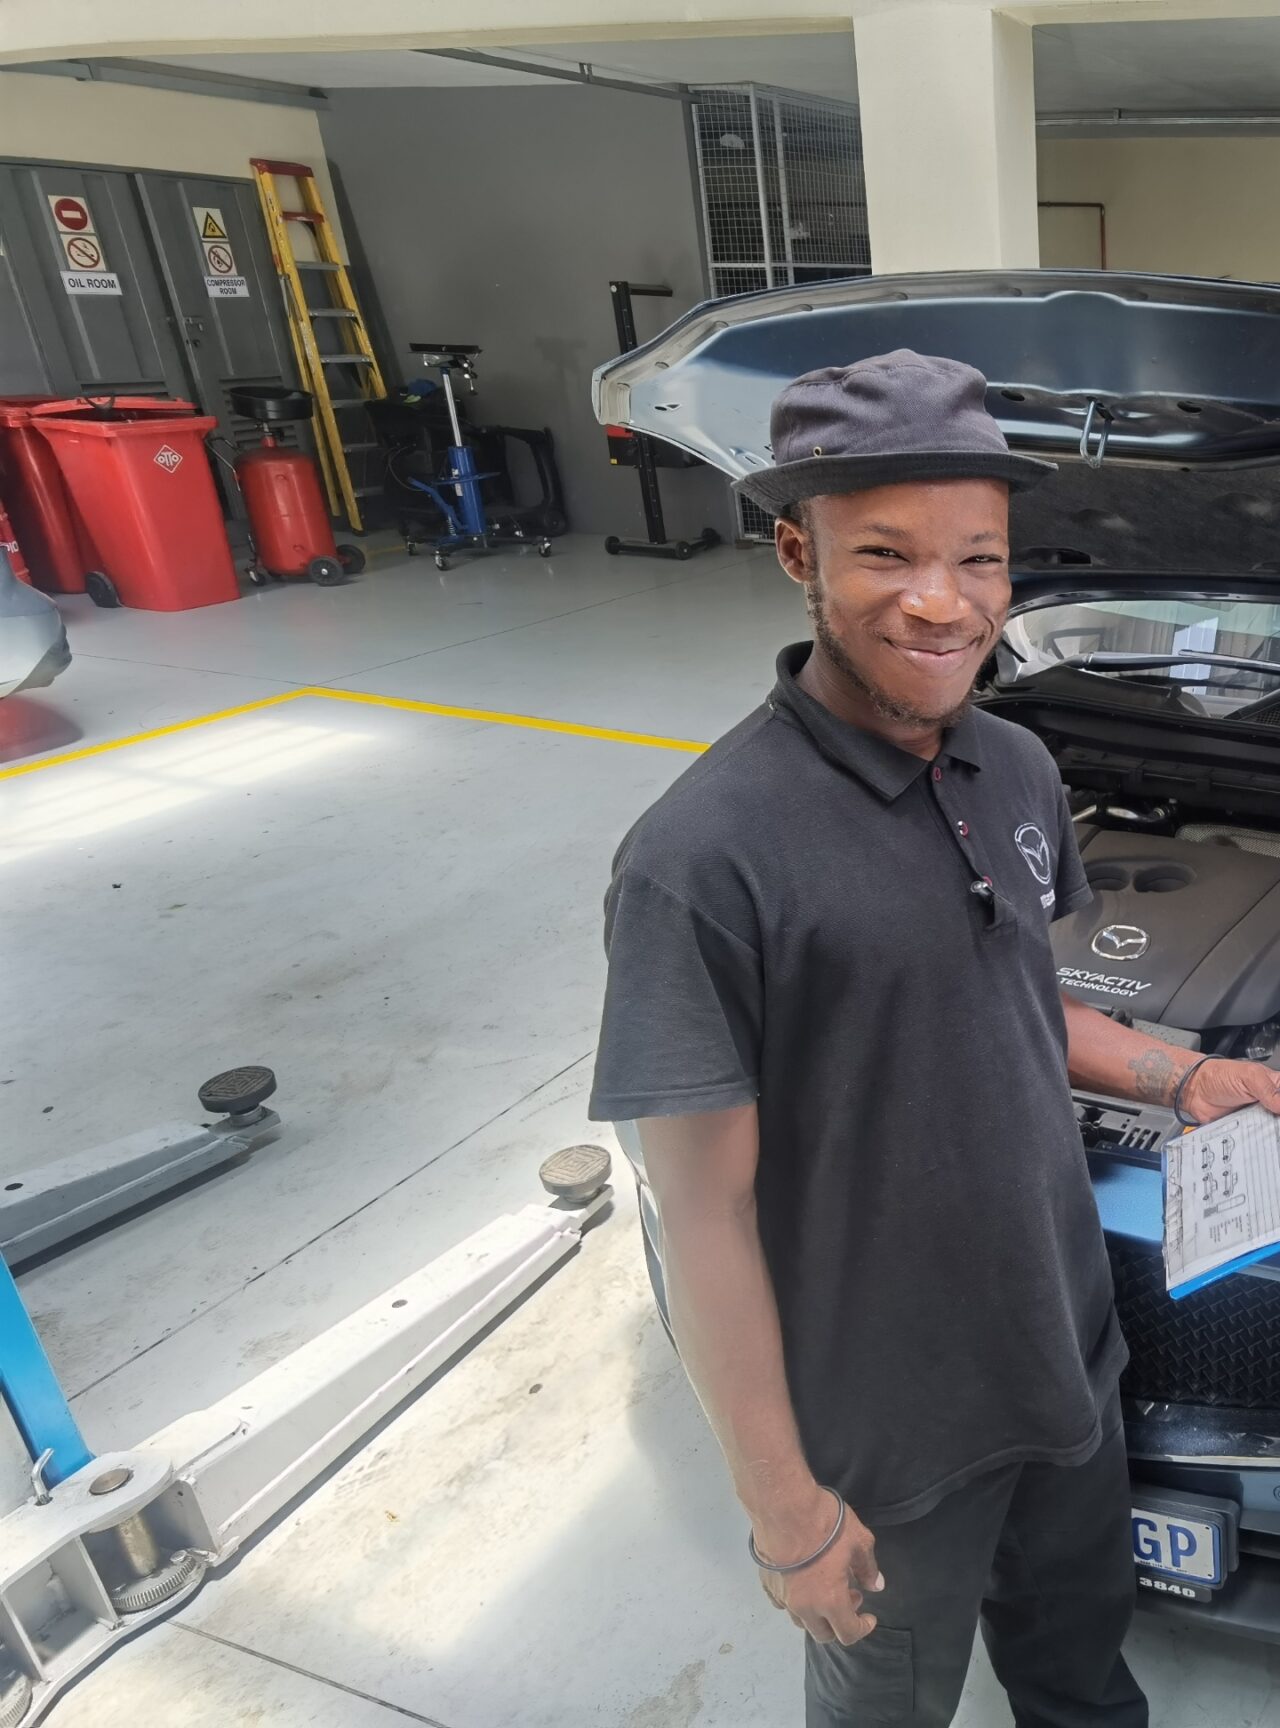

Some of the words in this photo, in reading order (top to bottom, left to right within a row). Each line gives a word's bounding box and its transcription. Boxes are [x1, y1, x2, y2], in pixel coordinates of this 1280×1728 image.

[68, 278, 86, 289] OIL
[88, 278, 117, 289] ROOM
[206, 278, 245, 288] COMPRESSOR
[219, 287, 238, 296] ROOM
[157, 451, 179, 466] OTTO
[1056, 967, 1152, 991] SKYACTIV
[1060, 977, 1139, 998] TECHNOLOGY
[1132, 1516, 1198, 1568] GP
